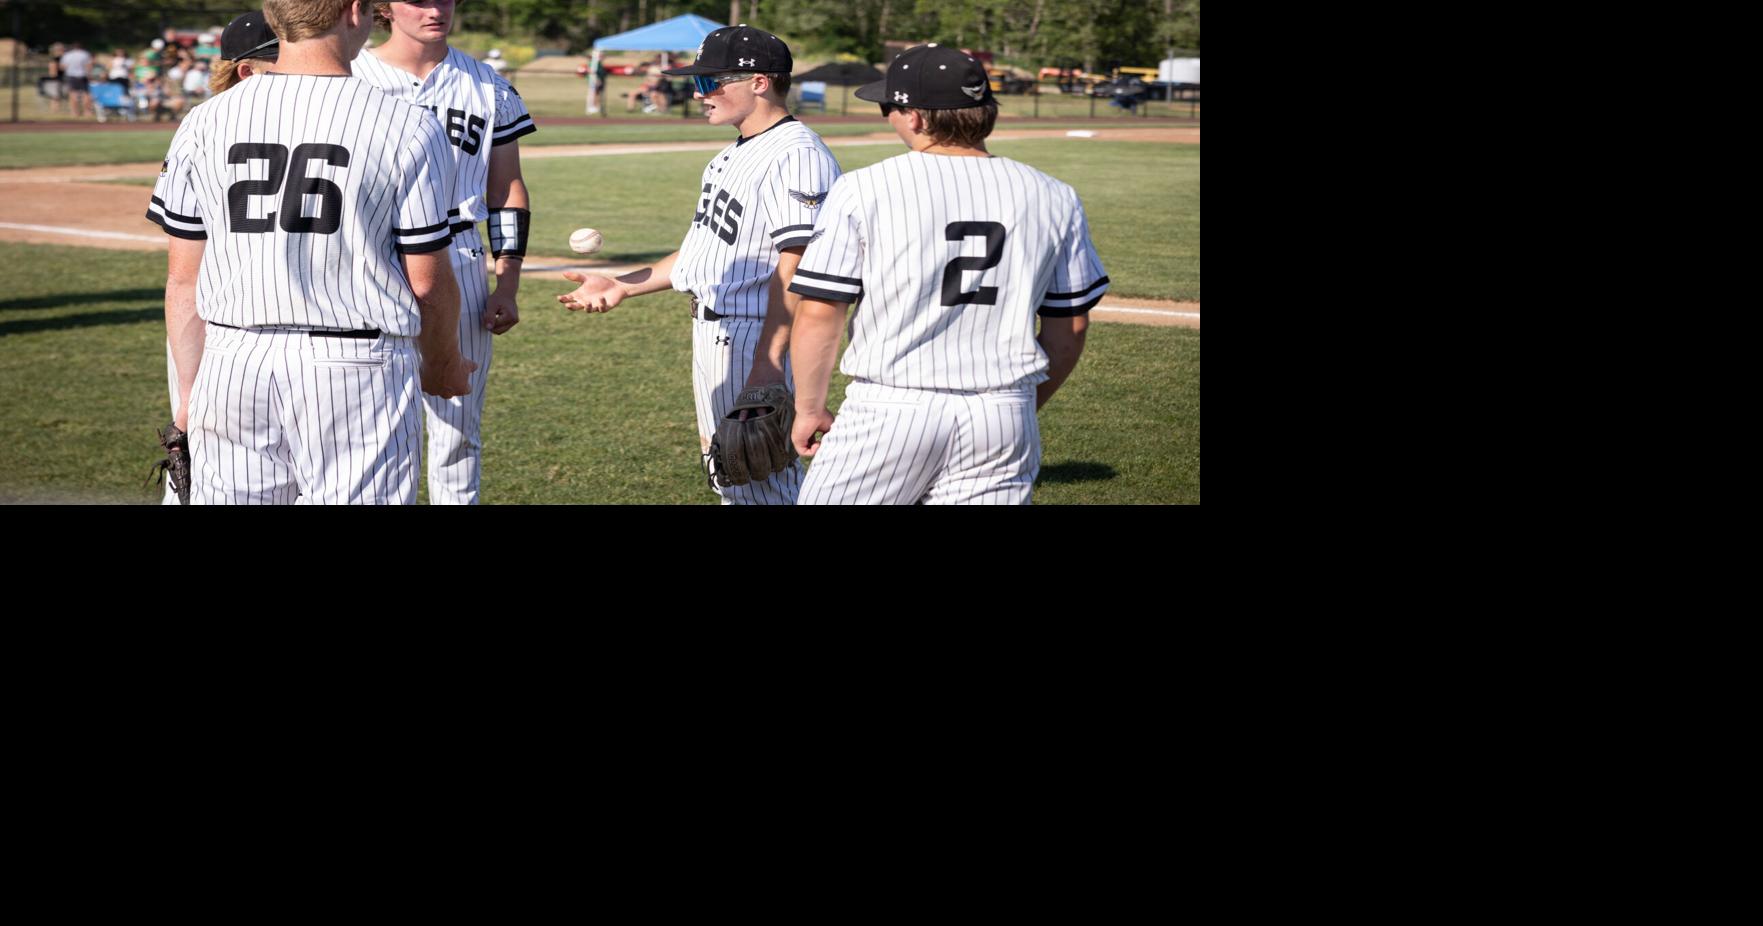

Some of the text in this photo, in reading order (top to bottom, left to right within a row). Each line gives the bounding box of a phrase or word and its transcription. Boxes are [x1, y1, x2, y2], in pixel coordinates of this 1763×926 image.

[431, 106, 486, 156] ES
[228, 142, 350, 234] 26
[940, 221, 1006, 306] 2
